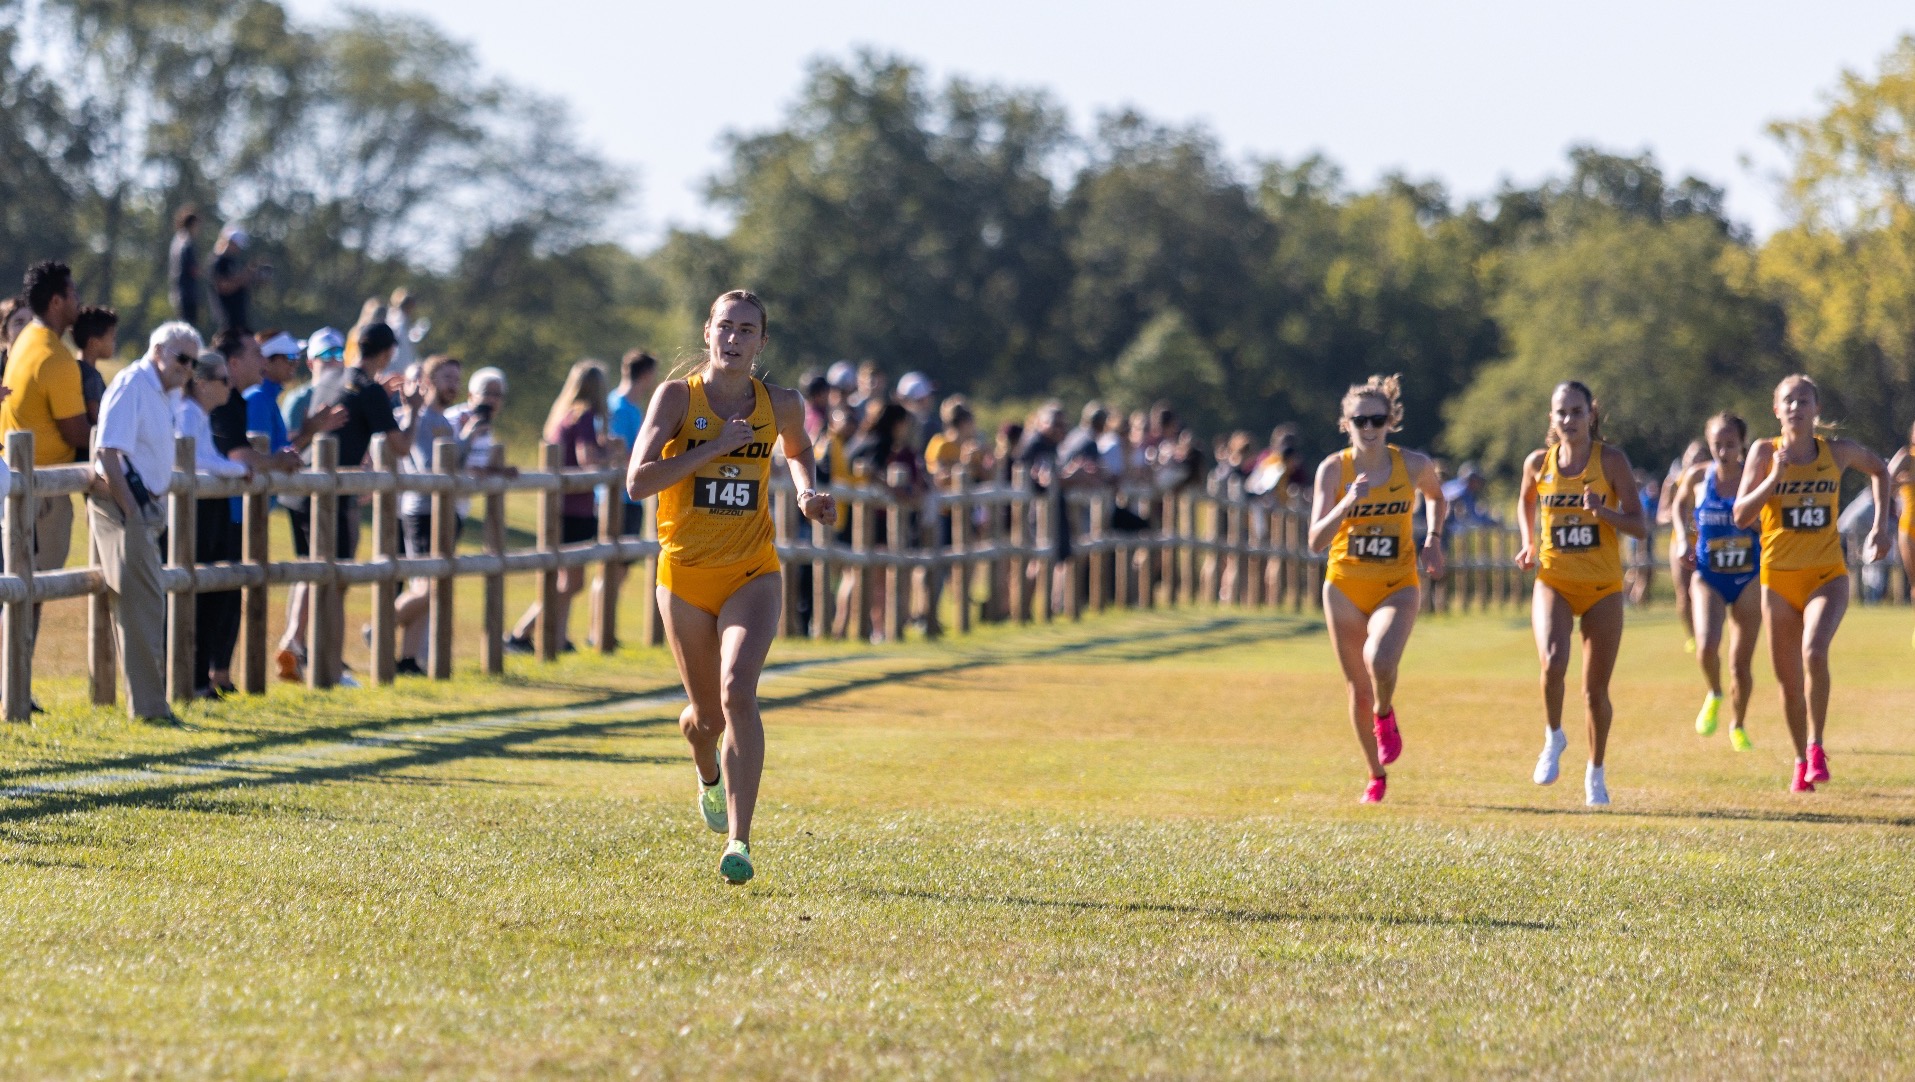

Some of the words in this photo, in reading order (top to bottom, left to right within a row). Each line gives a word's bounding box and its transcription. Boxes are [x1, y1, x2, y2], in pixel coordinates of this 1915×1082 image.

[705, 481, 750, 507] 145
[1775, 481, 1837, 495] IZZOU
[1347, 501, 1410, 517] IZZOU
[1790, 508, 1825, 527] 143
[1556, 527, 1592, 547] 146
[1354, 538, 1392, 557] 142
[1715, 550, 1747, 567] 177
